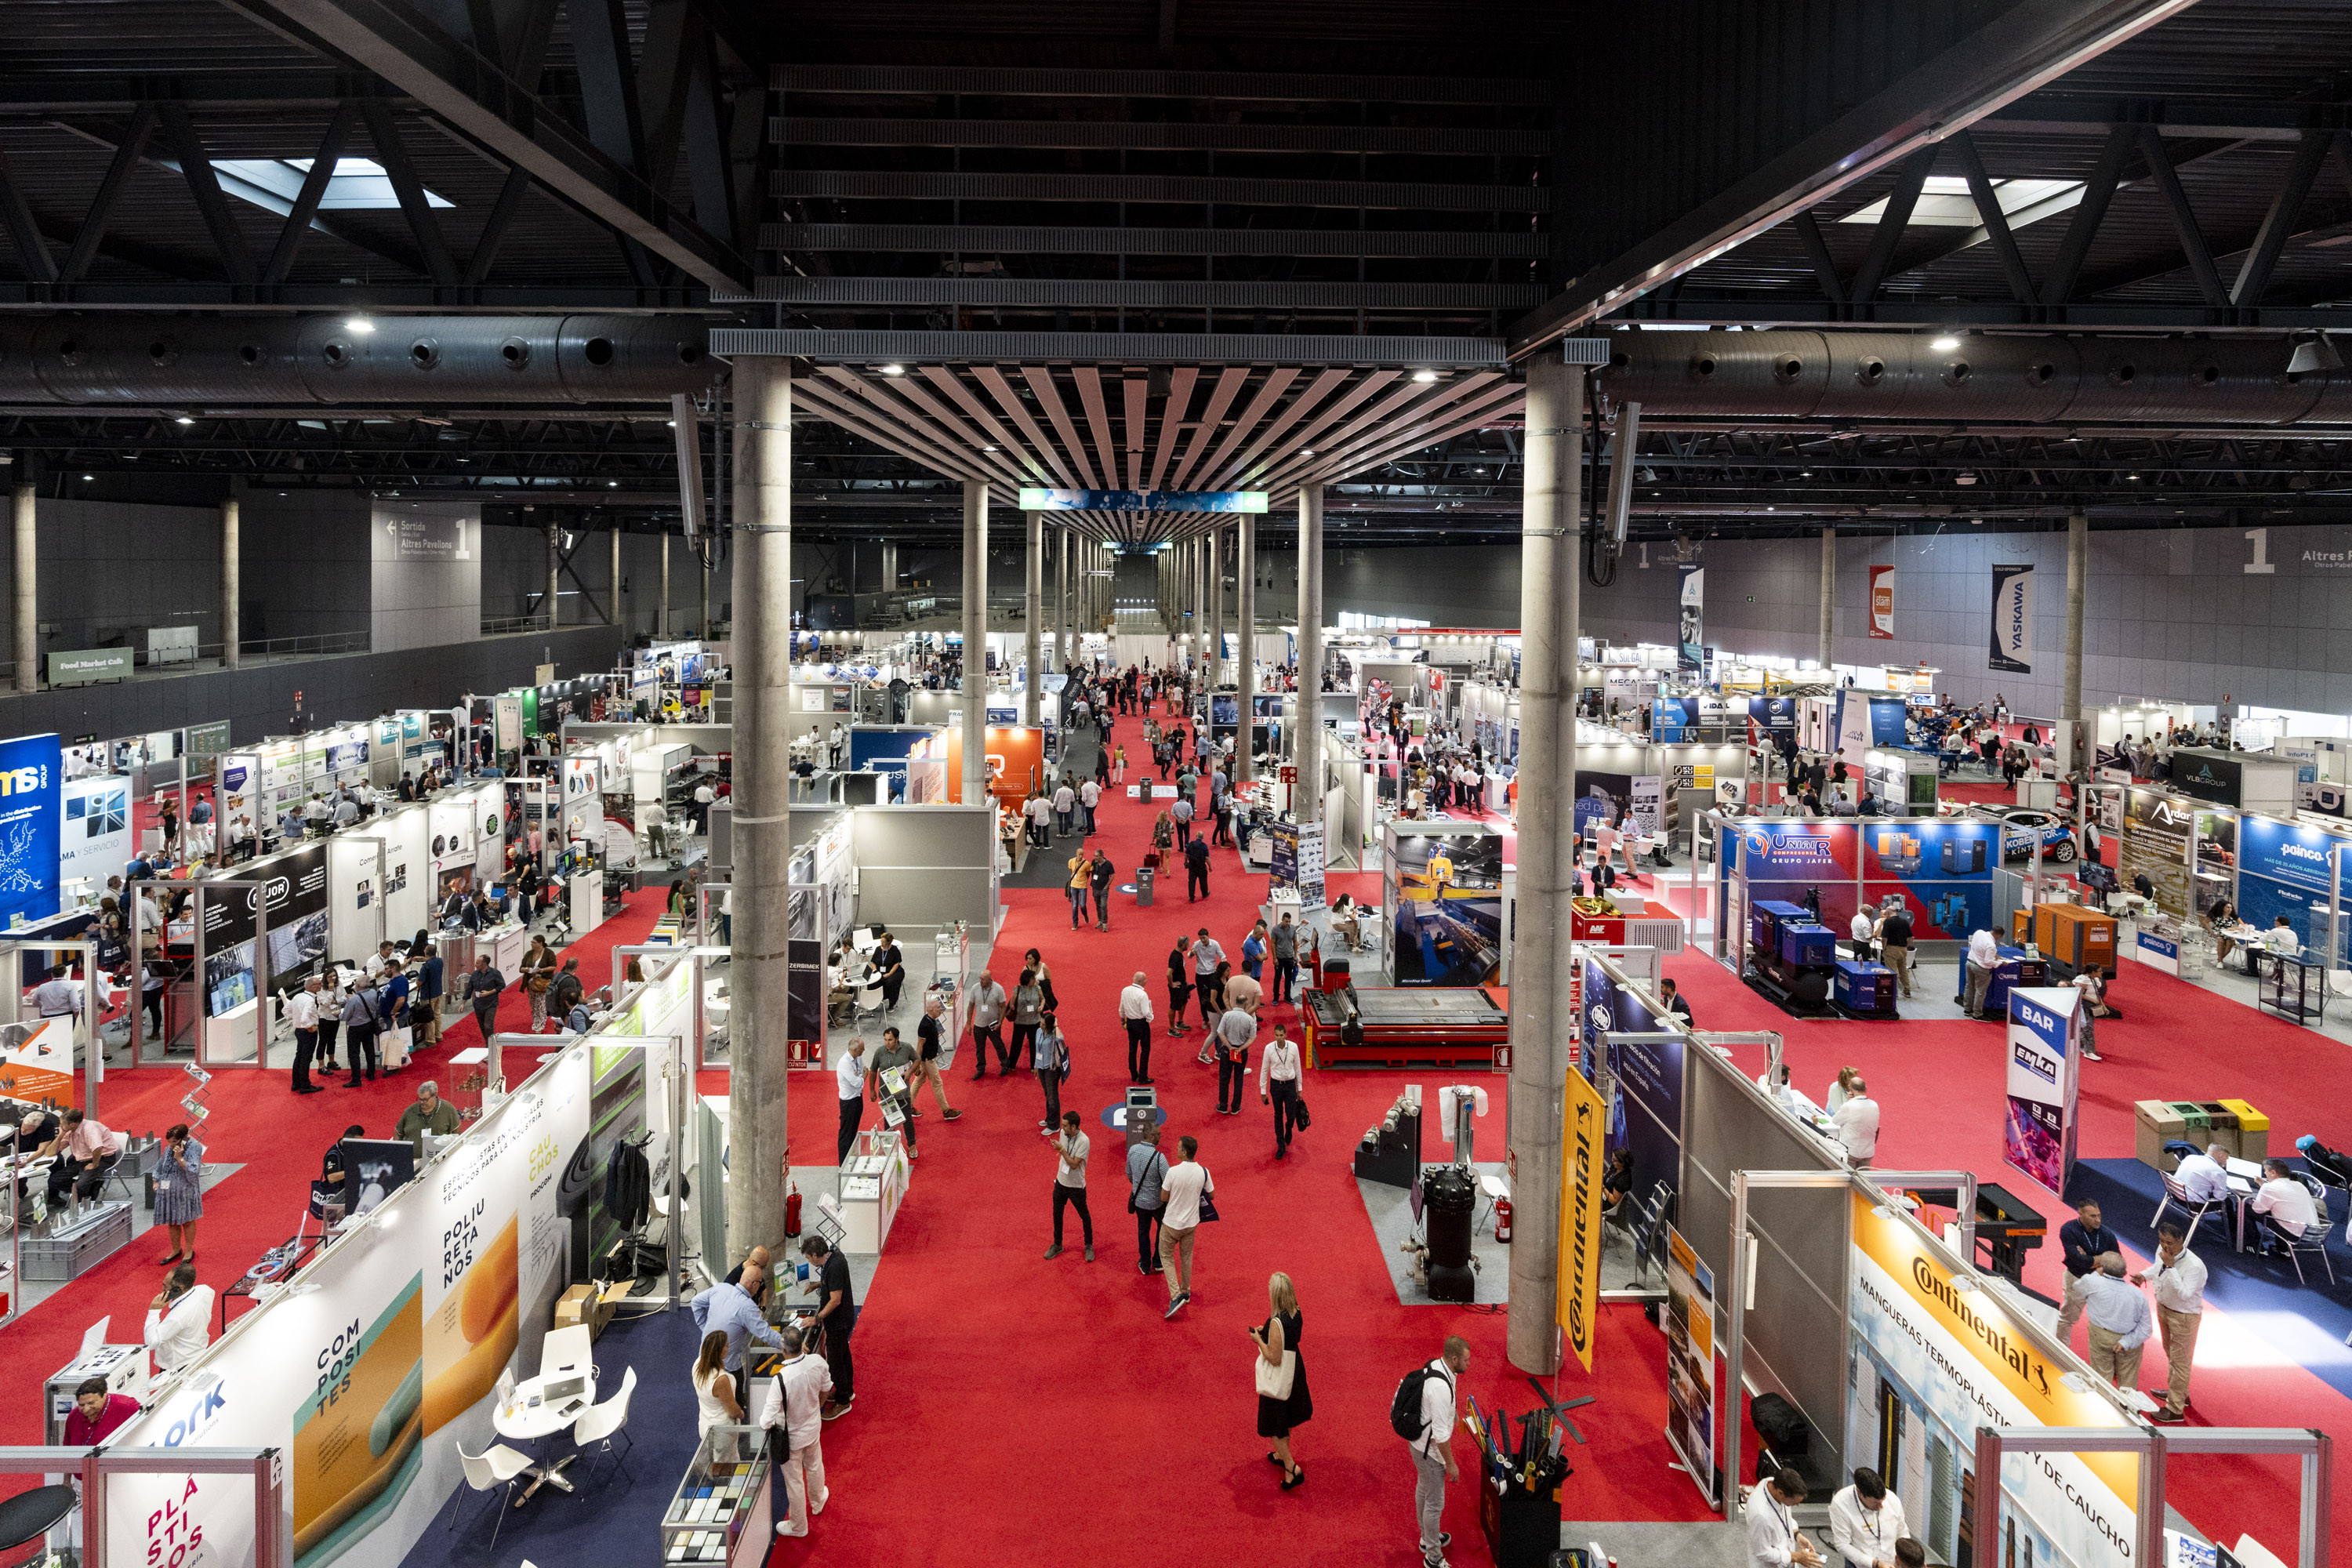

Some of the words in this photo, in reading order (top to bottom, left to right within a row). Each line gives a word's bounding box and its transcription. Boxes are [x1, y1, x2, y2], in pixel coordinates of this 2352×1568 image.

[401, 521, 426, 532] Sortida
[456, 519, 470, 559] 1
[401, 539, 421, 549] Altres
[423, 539, 452, 549] Pavellons
[1639, 542, 1650, 568] 1
[2244, 528, 2275, 574] 1
[2302, 550, 2344, 561] Altres
[1875, 595, 1890, 607] stam
[2013, 581, 2024, 652] YASKAWA
[60, 661, 78, 670] Food
[80, 659, 107, 669] Market
[2187, 774, 2227, 787] VLBGROUP
[13, 804, 42, 815] distribution
[1594, 804, 1619, 815] parts
[2131, 823, 2152, 832] PROCESOS
[2140, 831, 2165, 842] GARANTIZAN
[83, 839, 119, 855] SERVICIO
[387, 844, 402, 855] Arrate
[2131, 843, 2153, 854] NUESTROS
[2152, 848, 2172, 858] CLIENTES
[2147, 839, 2165, 848] SERVICIO
[2281, 843, 2324, 862] painco
[2303, 867, 2330, 878] ABRIENDO
[2143, 935, 2164, 949] painco
[2022, 1004, 2054, 1033] BAR
[2016, 1047, 2056, 1076] EMKA
[481, 1151, 498, 1171] PARA
[499, 1142, 508, 1153] LA
[510, 1112, 542, 1145] INDUSTRIA
[497, 1134, 506, 1145] EN
[529, 1134, 550, 1164] CAU
[529, 1144, 559, 1182] CHOS
[530, 1173, 553, 1201] PROCOM
[443, 1198, 485, 1249] POLIU
[443, 1229, 479, 1269] RETA
[443, 1249, 473, 1290] NOS
[1911, 1256, 2031, 1382] Continental
[317, 1317, 359, 1370] COM
[318, 1338, 361, 1396] POSI
[317, 1373, 351, 1417] TES
[149, 1378, 227, 1447] ork
[1859, 1276, 1923, 1347] MANGUERAS
[2044, 1461, 2063, 1489] DE
[2066, 1483, 2131, 1559] CAUCHO
[273, 1465, 283, 1483] 17
[274, 1455, 281, 1468] A
[148, 1472, 198, 1540] PLÁ
[147, 1510, 187, 1566] STI
[157, 1525, 202, 1568] OS
